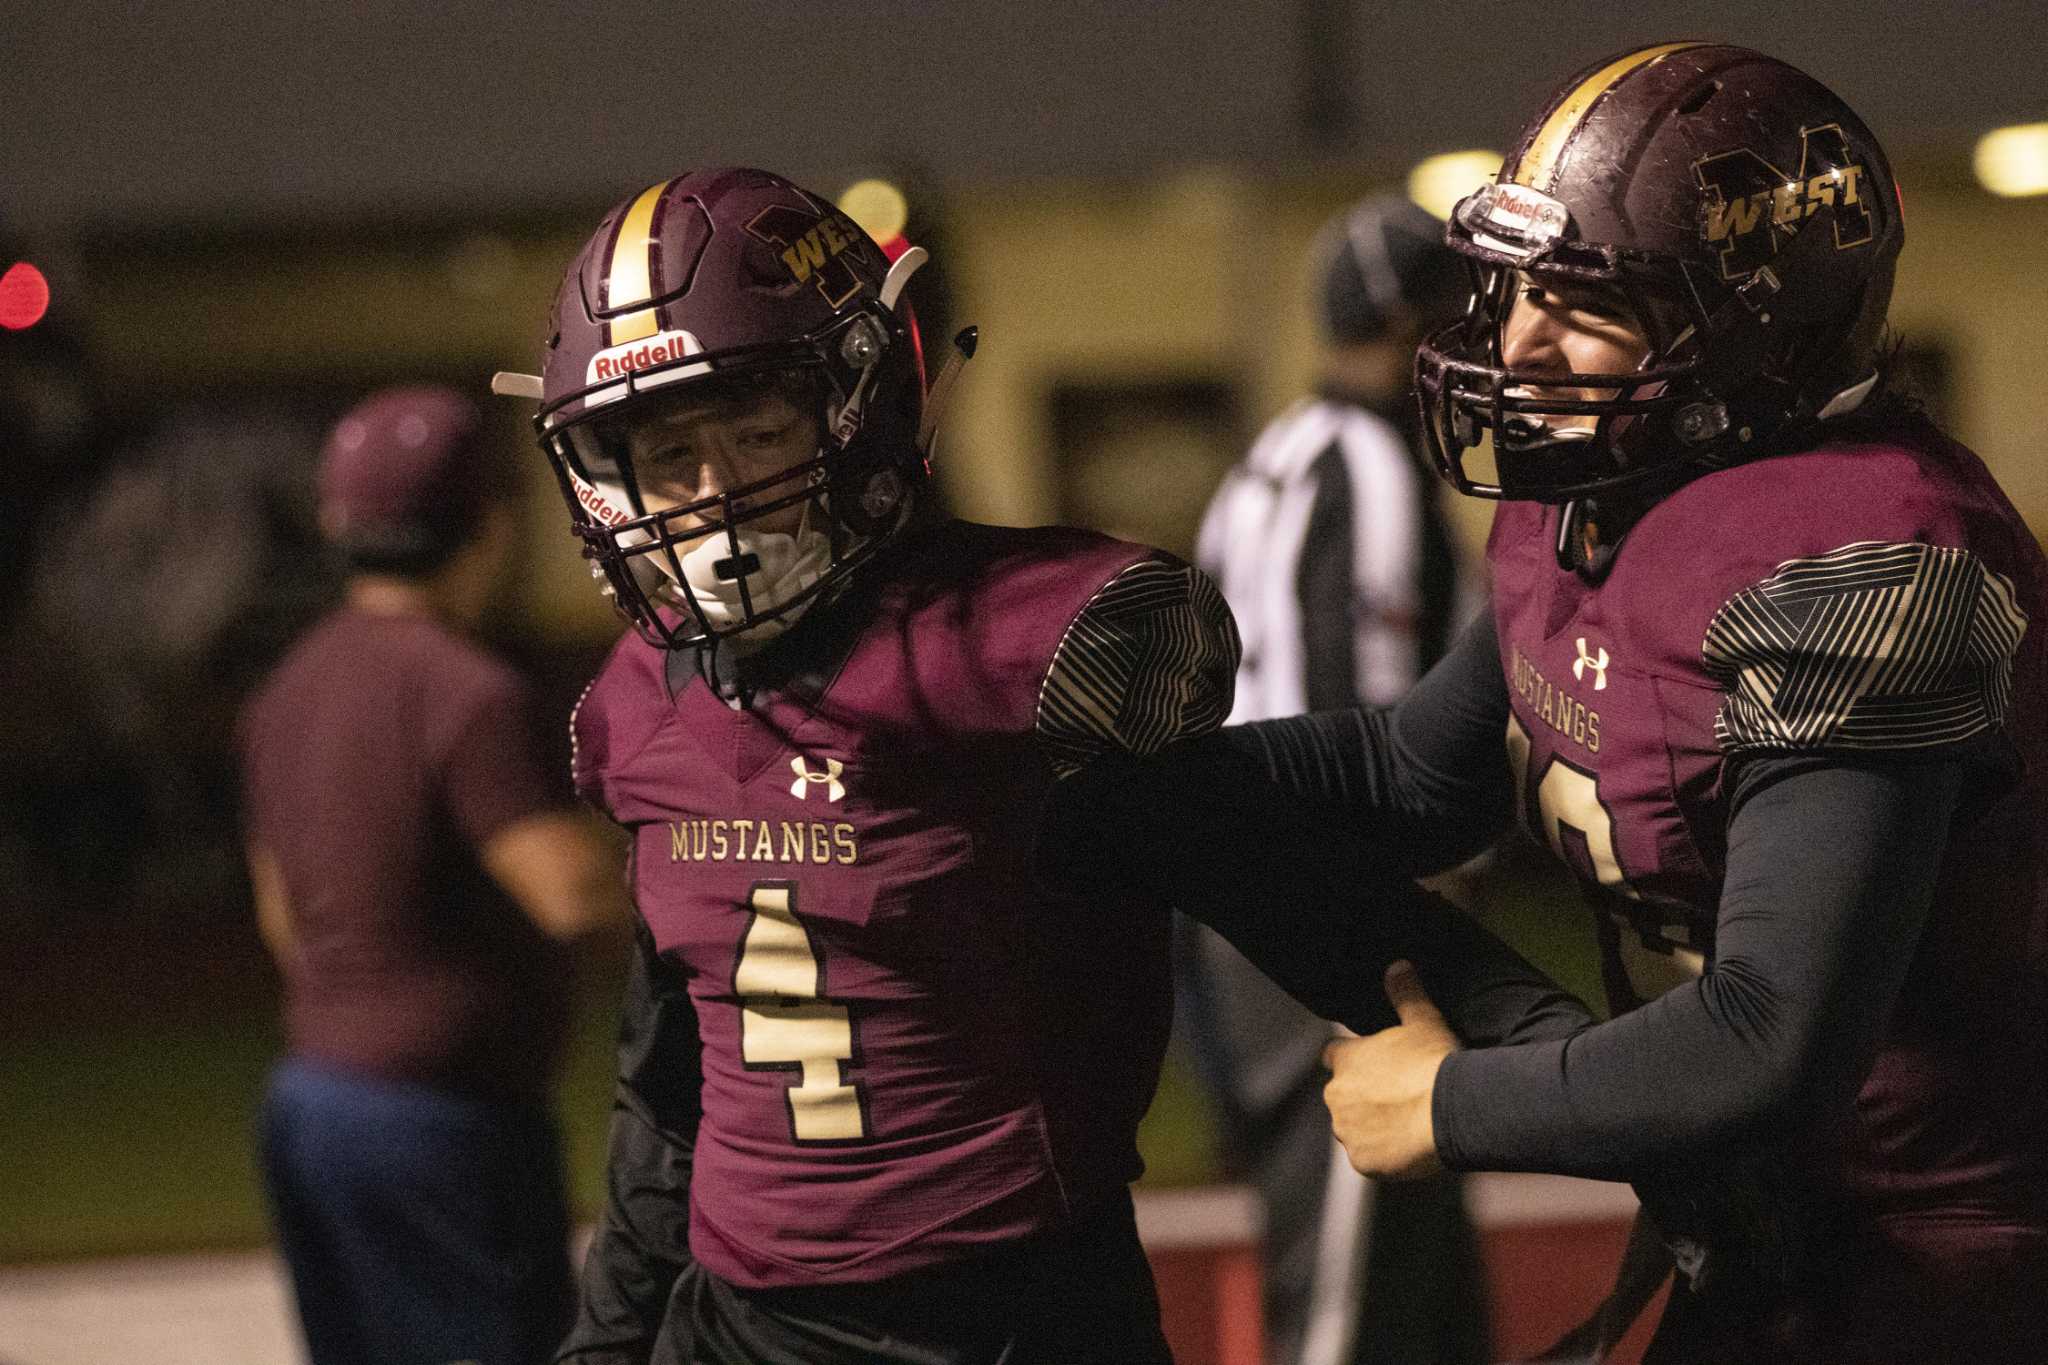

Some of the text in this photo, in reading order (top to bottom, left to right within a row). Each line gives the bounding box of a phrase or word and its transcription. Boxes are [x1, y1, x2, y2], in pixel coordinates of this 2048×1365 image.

[1704, 164, 1863, 241] WEST
[783, 215, 863, 283] WES
[595, 336, 684, 381] Riddell
[1510, 642, 1600, 754] MUSTANGS
[670, 819, 858, 865] MUSTANGS
[734, 886, 866, 1142] 4
